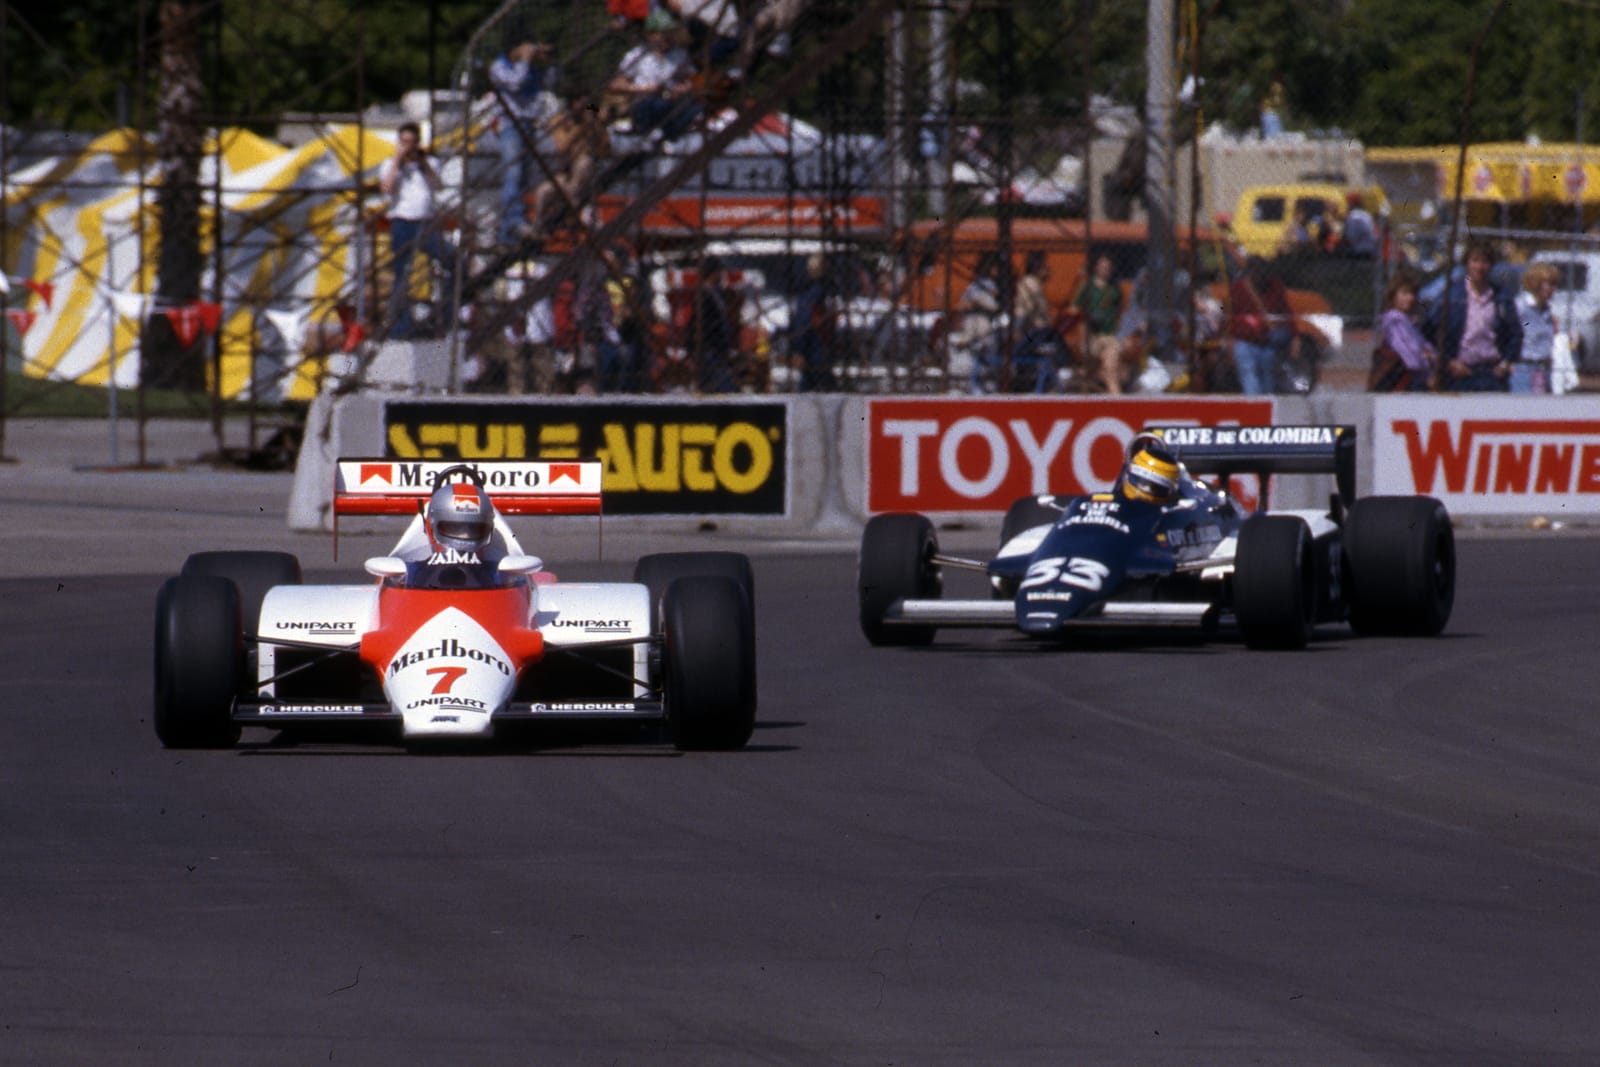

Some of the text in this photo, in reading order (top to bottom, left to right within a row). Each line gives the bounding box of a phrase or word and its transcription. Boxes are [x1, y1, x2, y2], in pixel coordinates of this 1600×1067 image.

[1164, 427, 1212, 444] CAFE
[1239, 427, 1332, 444] COLOMBIA
[595, 421, 773, 494] AUTO
[882, 416, 1259, 505] TOYO
[276, 621, 356, 630] UNIPART
[551, 619, 632, 628] UNIPART
[389, 639, 510, 679] Marlboro
[426, 666, 467, 695] 7
[406, 696, 487, 709] UNIPART
